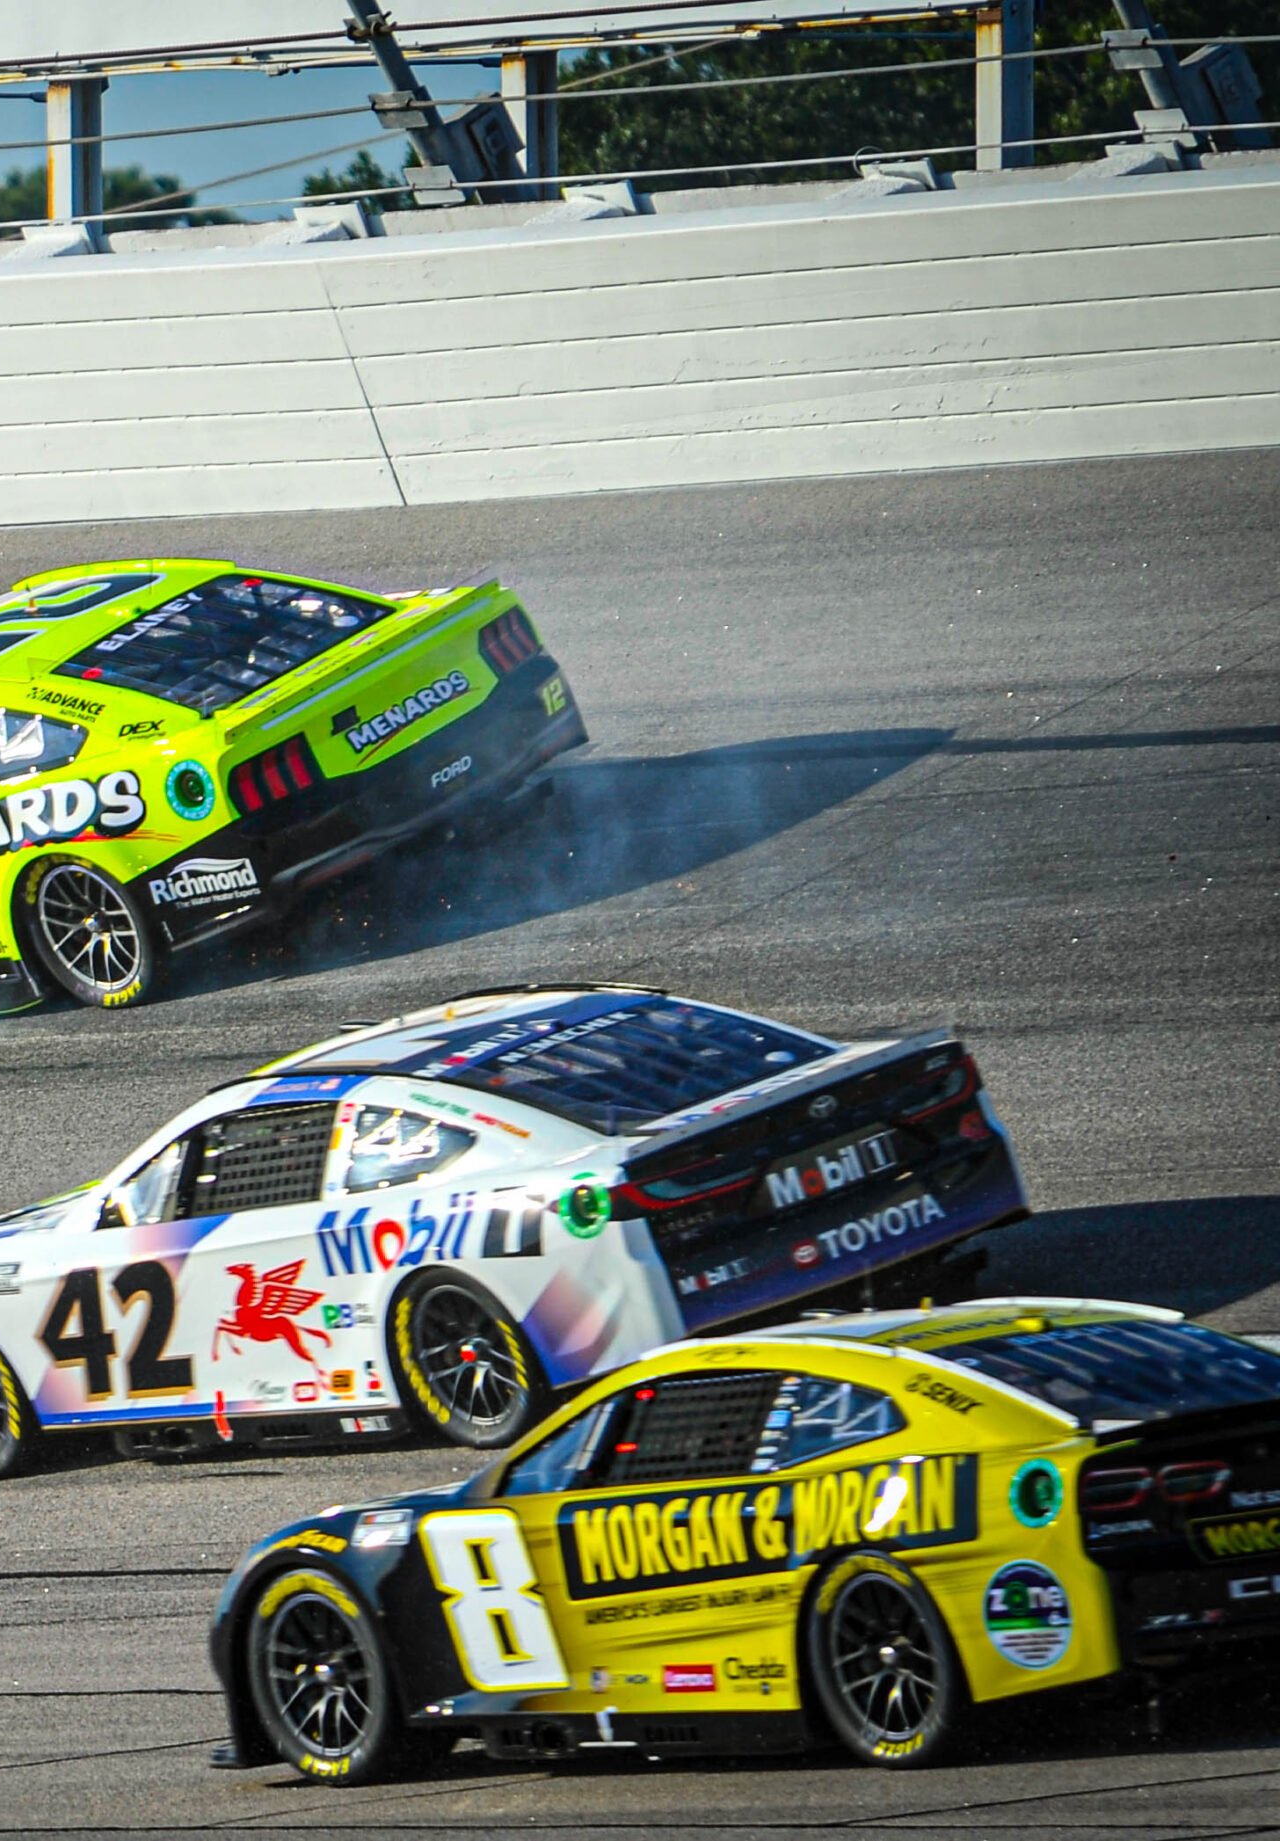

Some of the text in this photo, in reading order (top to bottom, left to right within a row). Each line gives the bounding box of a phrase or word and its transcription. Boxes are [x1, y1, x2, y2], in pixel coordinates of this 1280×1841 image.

[40, 691, 106, 716] ADVANCE
[119, 719, 165, 737] DEX
[346, 670, 469, 751] MENARDS
[541, 677, 566, 717] 12
[431, 755, 471, 789] FORD
[148, 859, 257, 905] Richmond
[766, 1145, 864, 1209] Mobil
[318, 1190, 477, 1277] Mobil
[817, 1193, 946, 1259] TOYOTA
[34, 1260, 197, 1402] 42
[573, 1456, 955, 1584] MORGAN & MORGAN
[419, 1507, 570, 1692] 8
